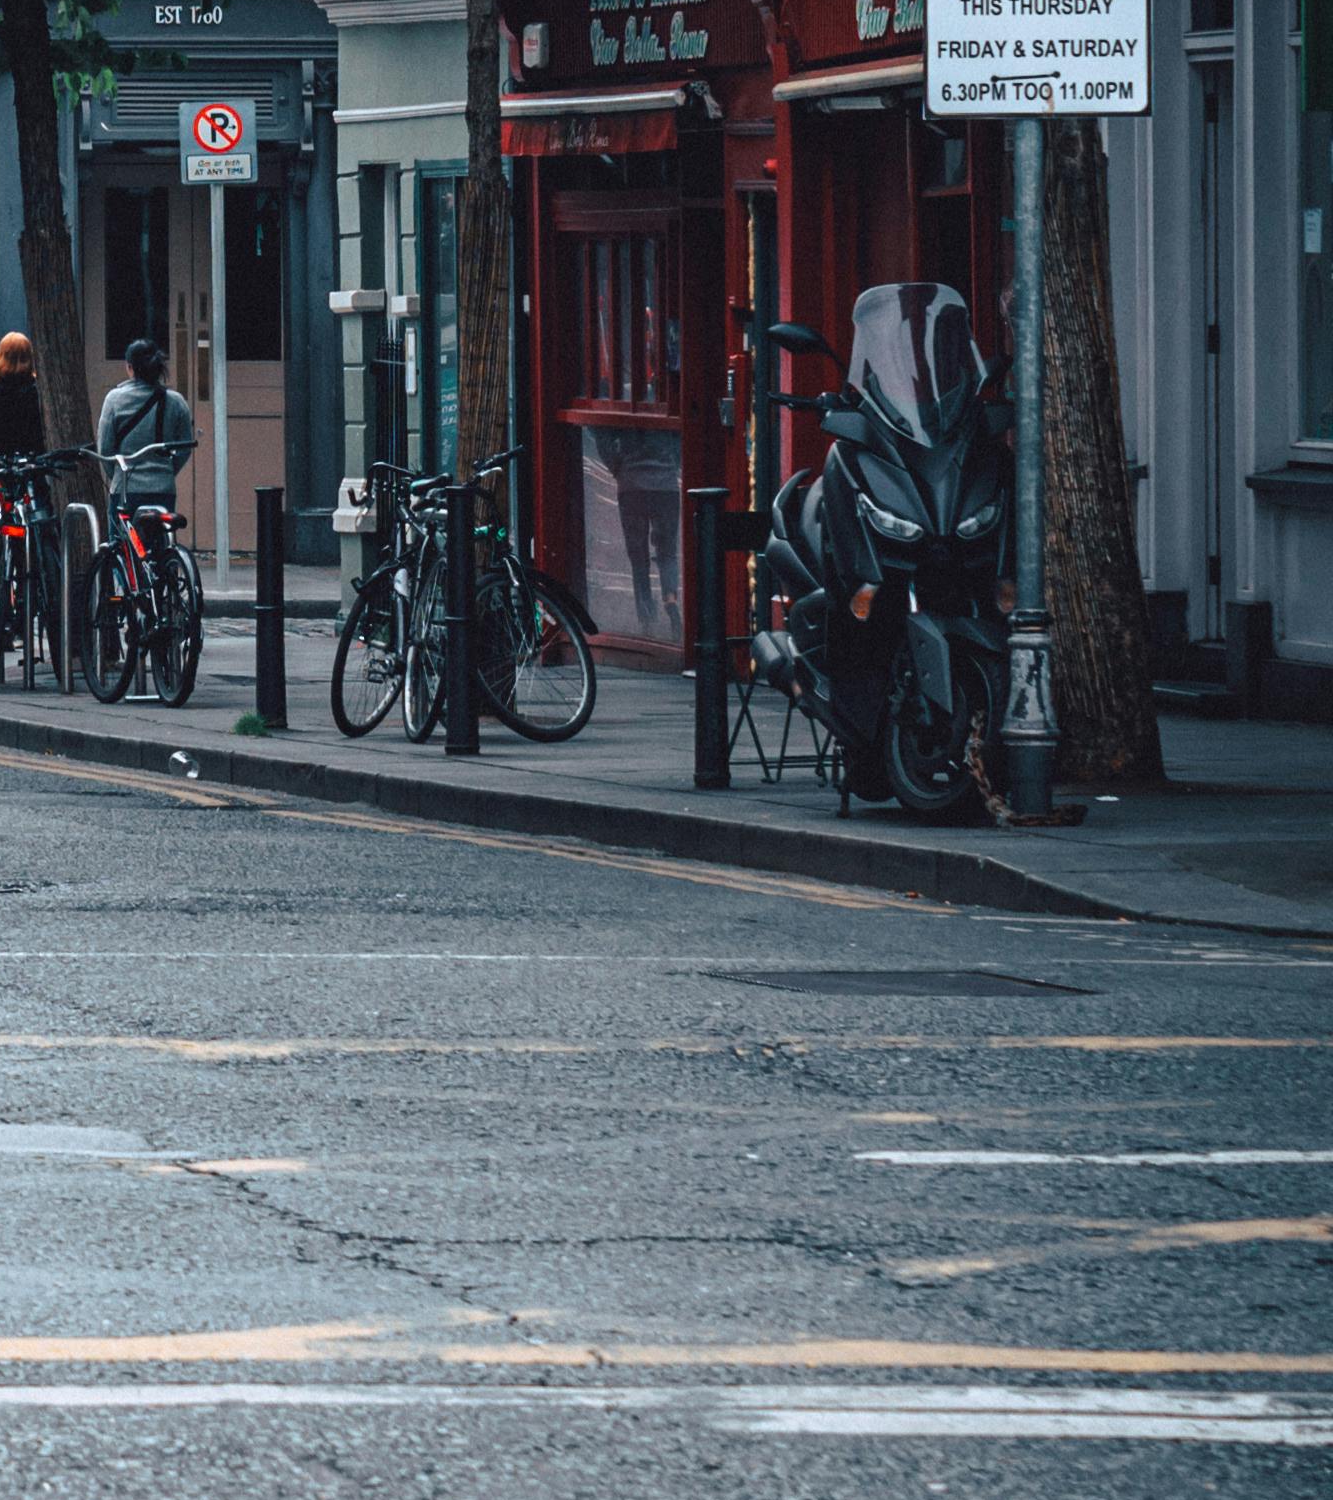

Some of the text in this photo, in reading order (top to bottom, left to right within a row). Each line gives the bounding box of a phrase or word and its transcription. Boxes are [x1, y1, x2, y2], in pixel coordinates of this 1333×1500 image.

[155, 6, 182, 25] EST
[937, 39, 1138, 59] FRIDAY & SATURDAY
[941, 81, 1134, 101] 6.30PM TOO 11.00PM
